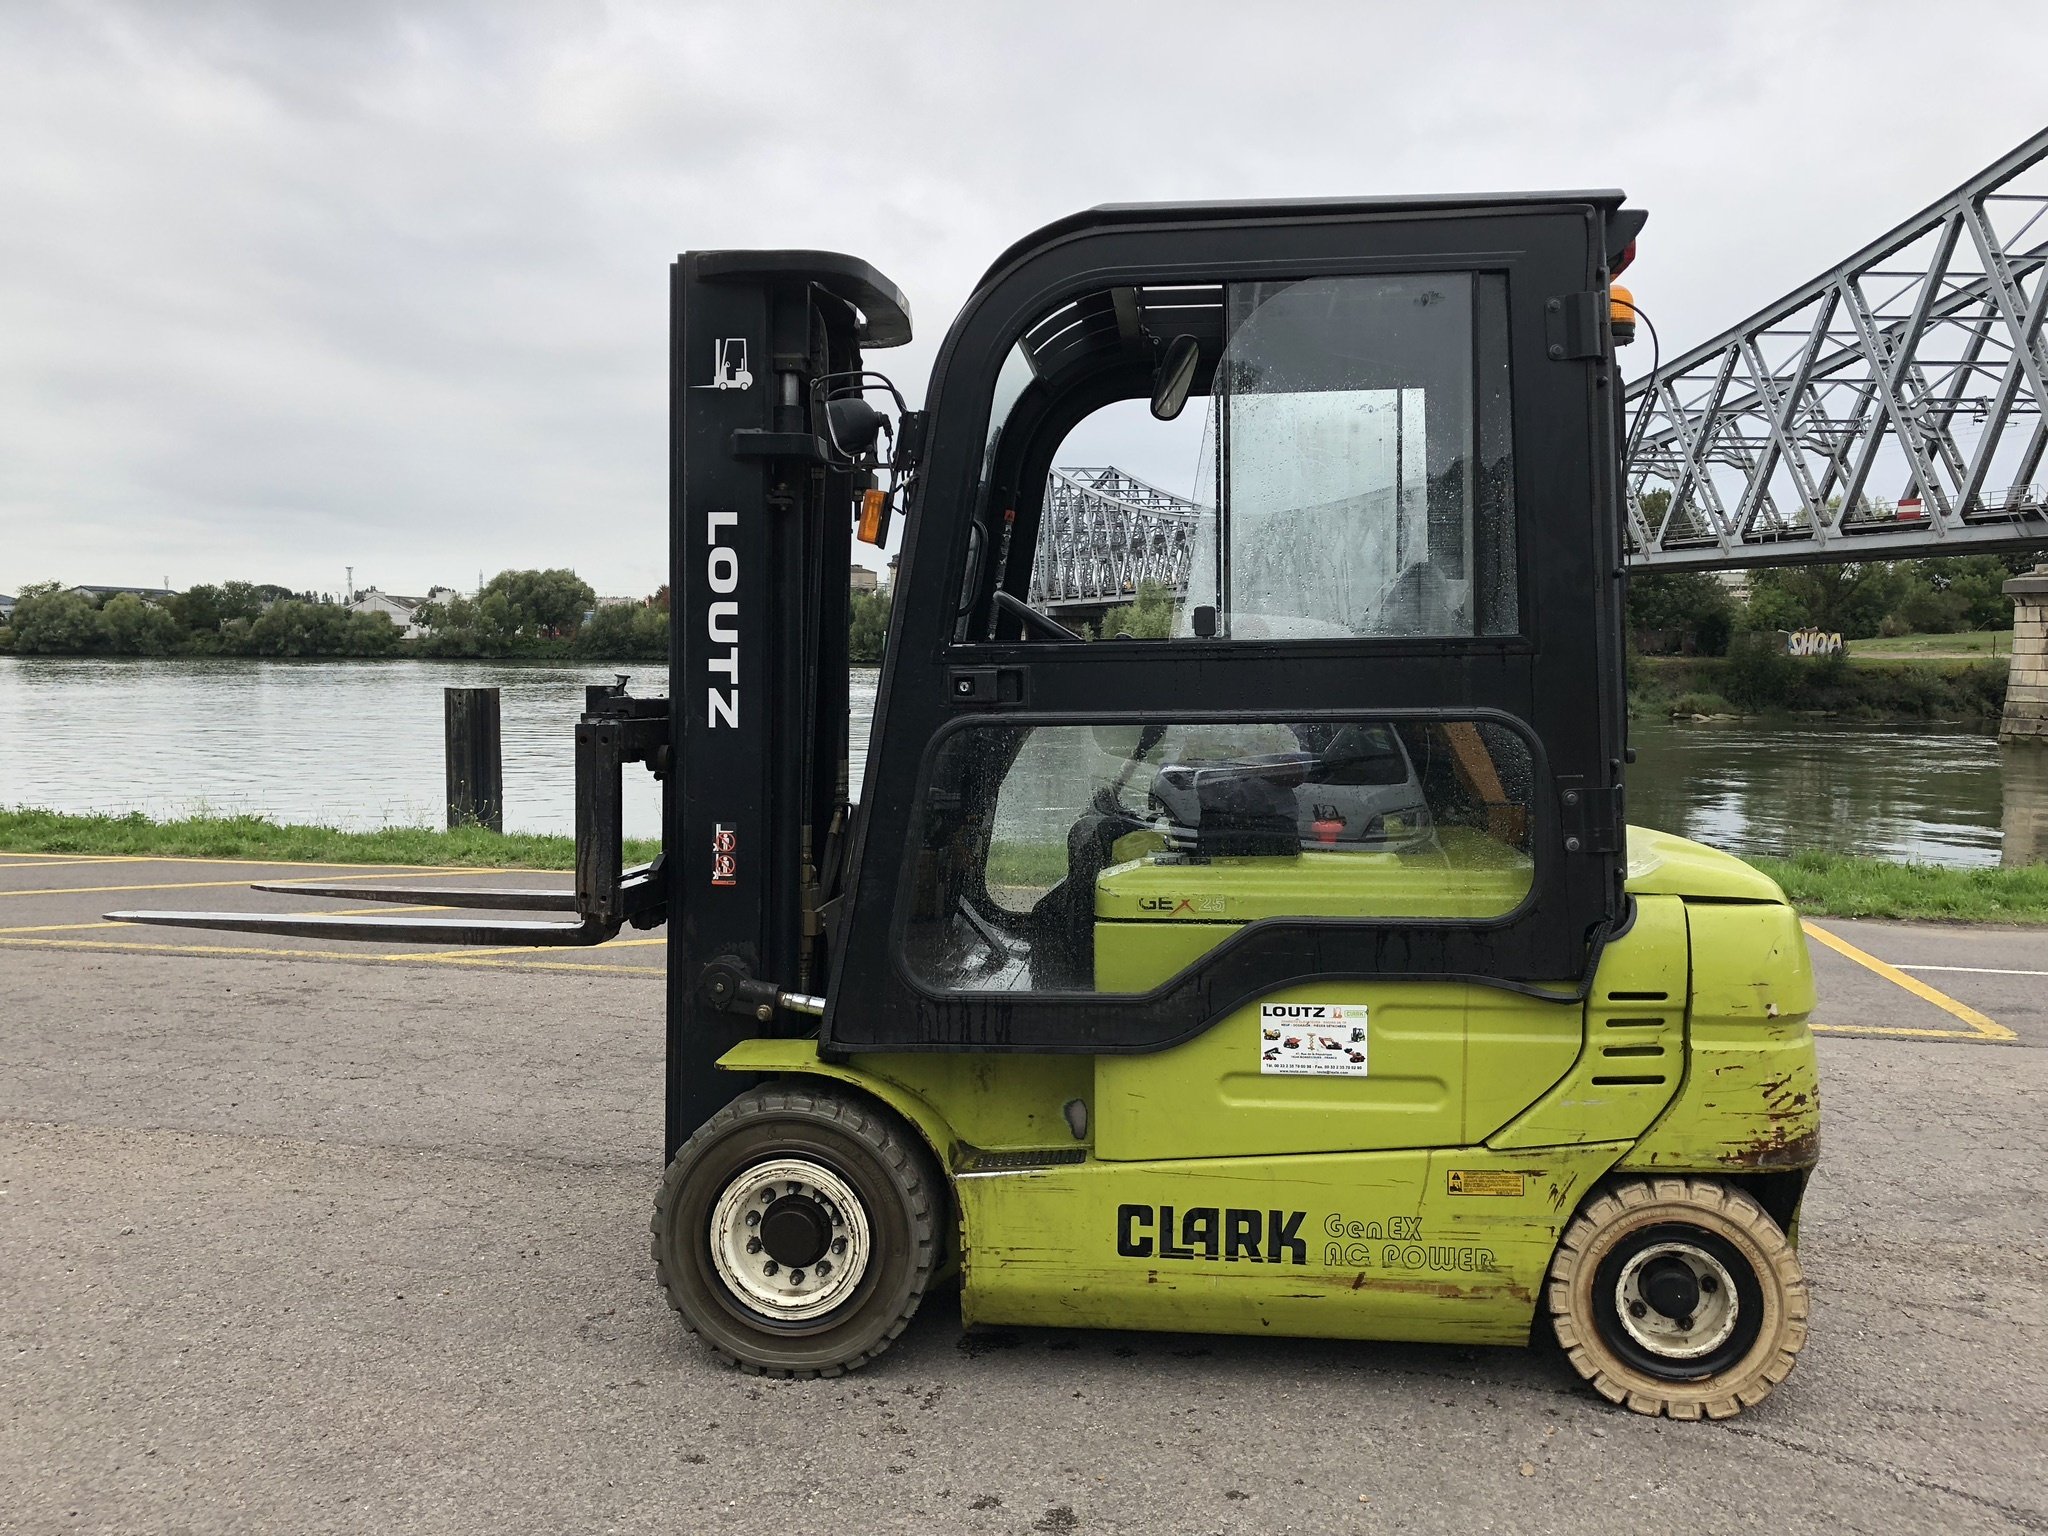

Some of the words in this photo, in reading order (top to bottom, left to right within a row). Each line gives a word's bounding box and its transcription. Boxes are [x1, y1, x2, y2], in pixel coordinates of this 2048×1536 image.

[708, 511, 739, 729] LOUTZ
[1263, 1006, 1325, 1018] LOUTZ
[1117, 1204, 1307, 1266] CLARK
[1324, 1242, 1370, 1266] AC
[1382, 1244, 1499, 1273] POWER
